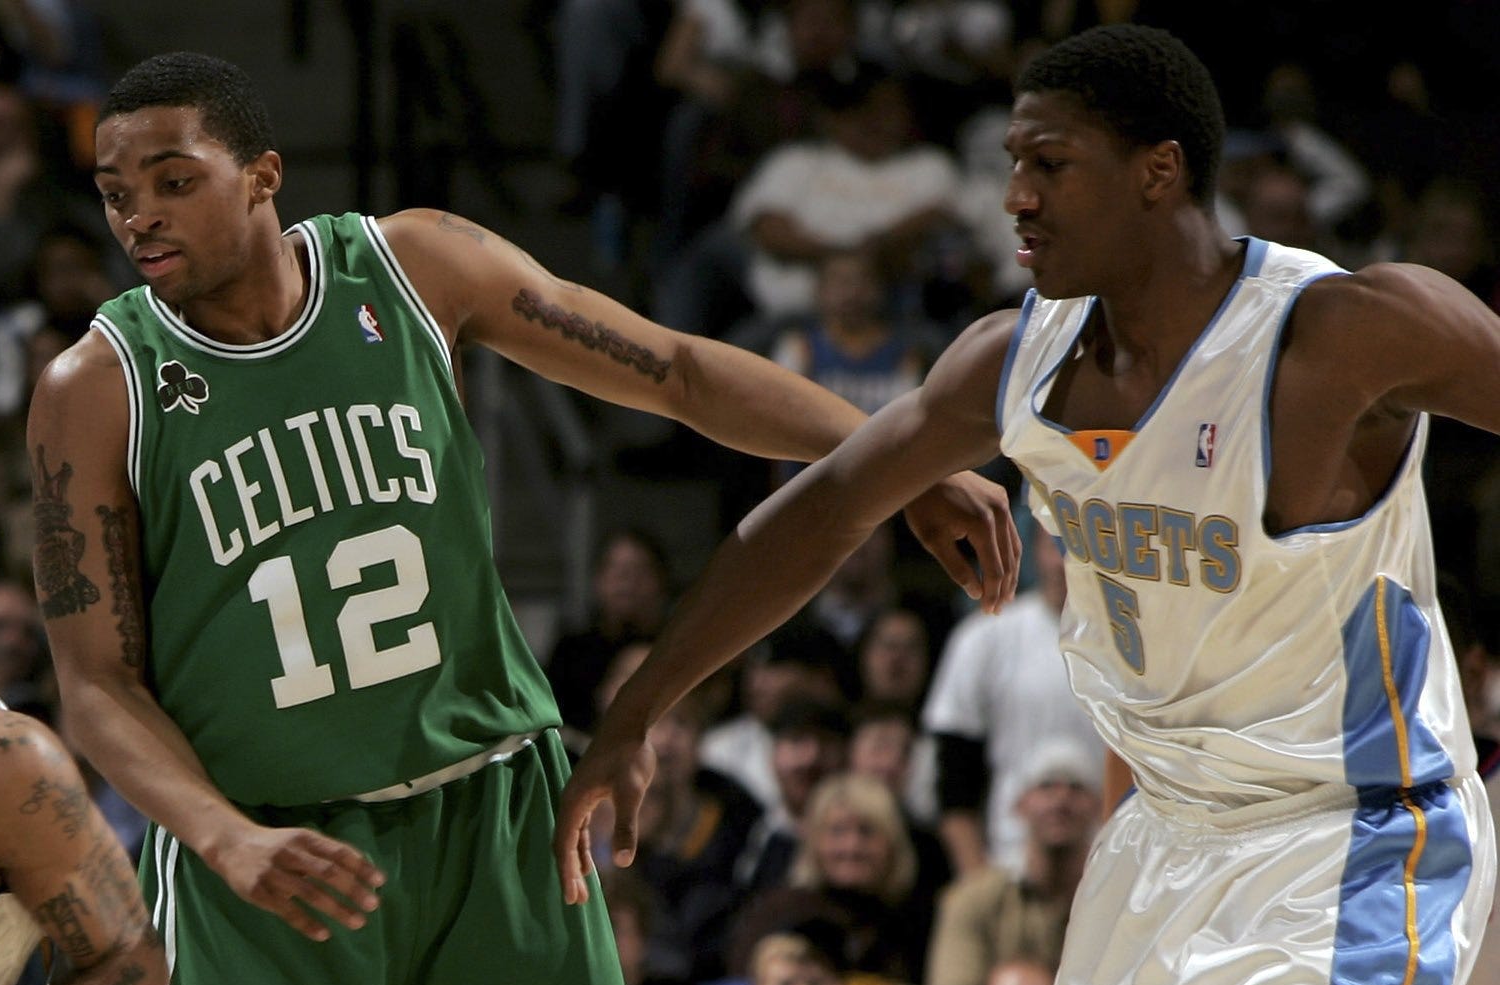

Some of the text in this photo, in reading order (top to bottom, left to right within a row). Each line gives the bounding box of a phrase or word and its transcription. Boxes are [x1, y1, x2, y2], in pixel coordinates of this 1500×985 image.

[189, 403, 438, 567] CELTICS
[1018, 464, 1242, 594] GGETS
[247, 523, 442, 710] 12
[1096, 570, 1146, 676] 5
